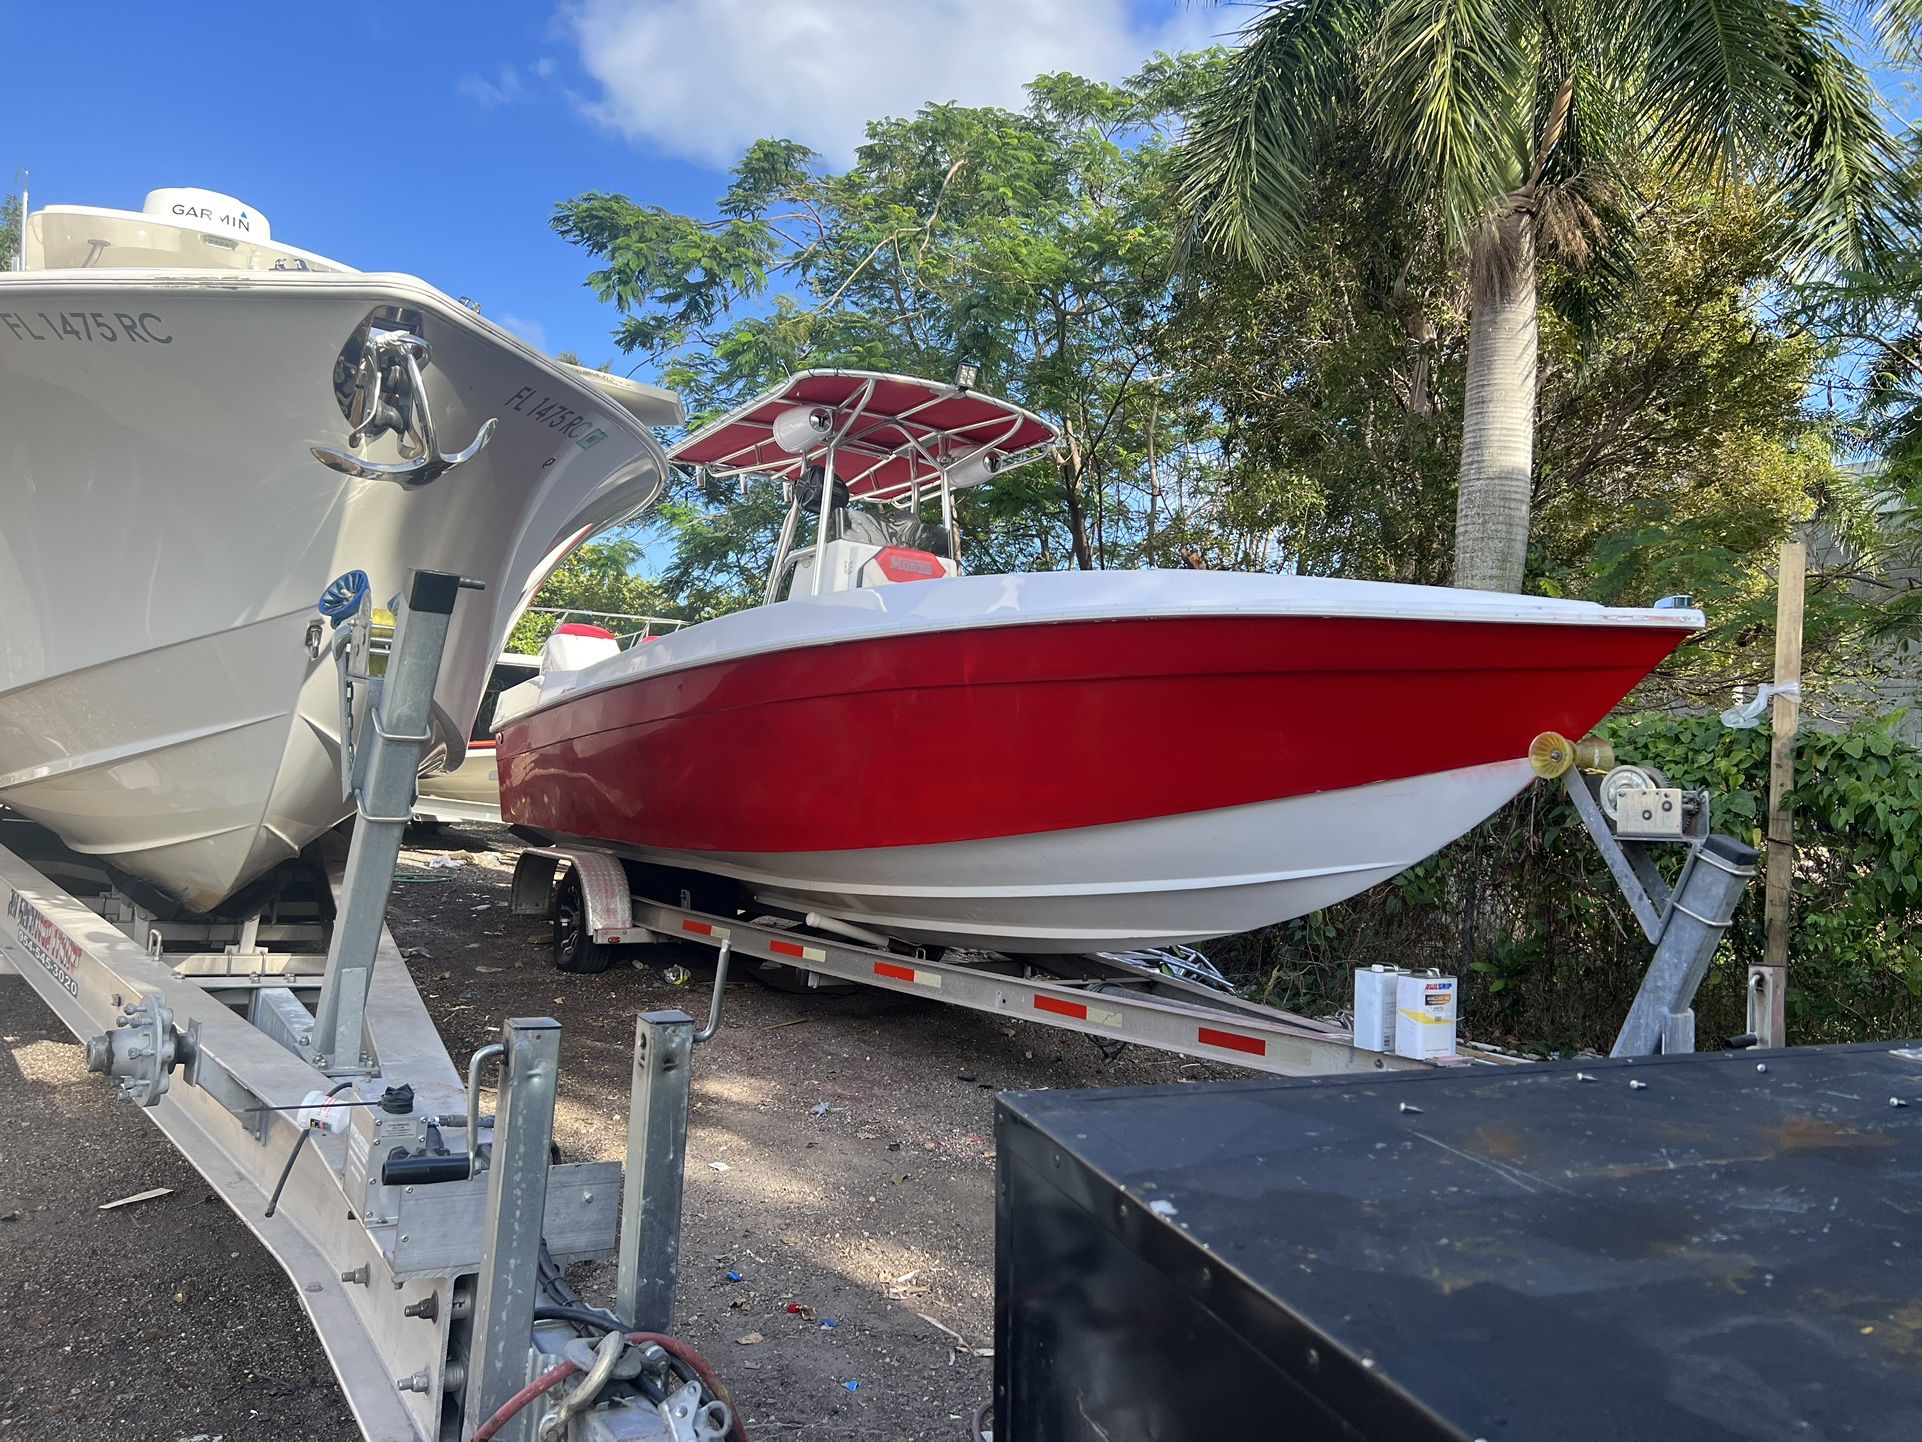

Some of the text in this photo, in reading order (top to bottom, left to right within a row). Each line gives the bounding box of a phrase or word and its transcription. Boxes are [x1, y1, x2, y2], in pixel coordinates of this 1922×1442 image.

[172, 204, 249, 232] GARMIN
[0, 312, 173, 344] FL 1475 RC
[504, 386, 593, 439] FL 1475 RC
[18, 930, 78, 996] 954-545-3020
